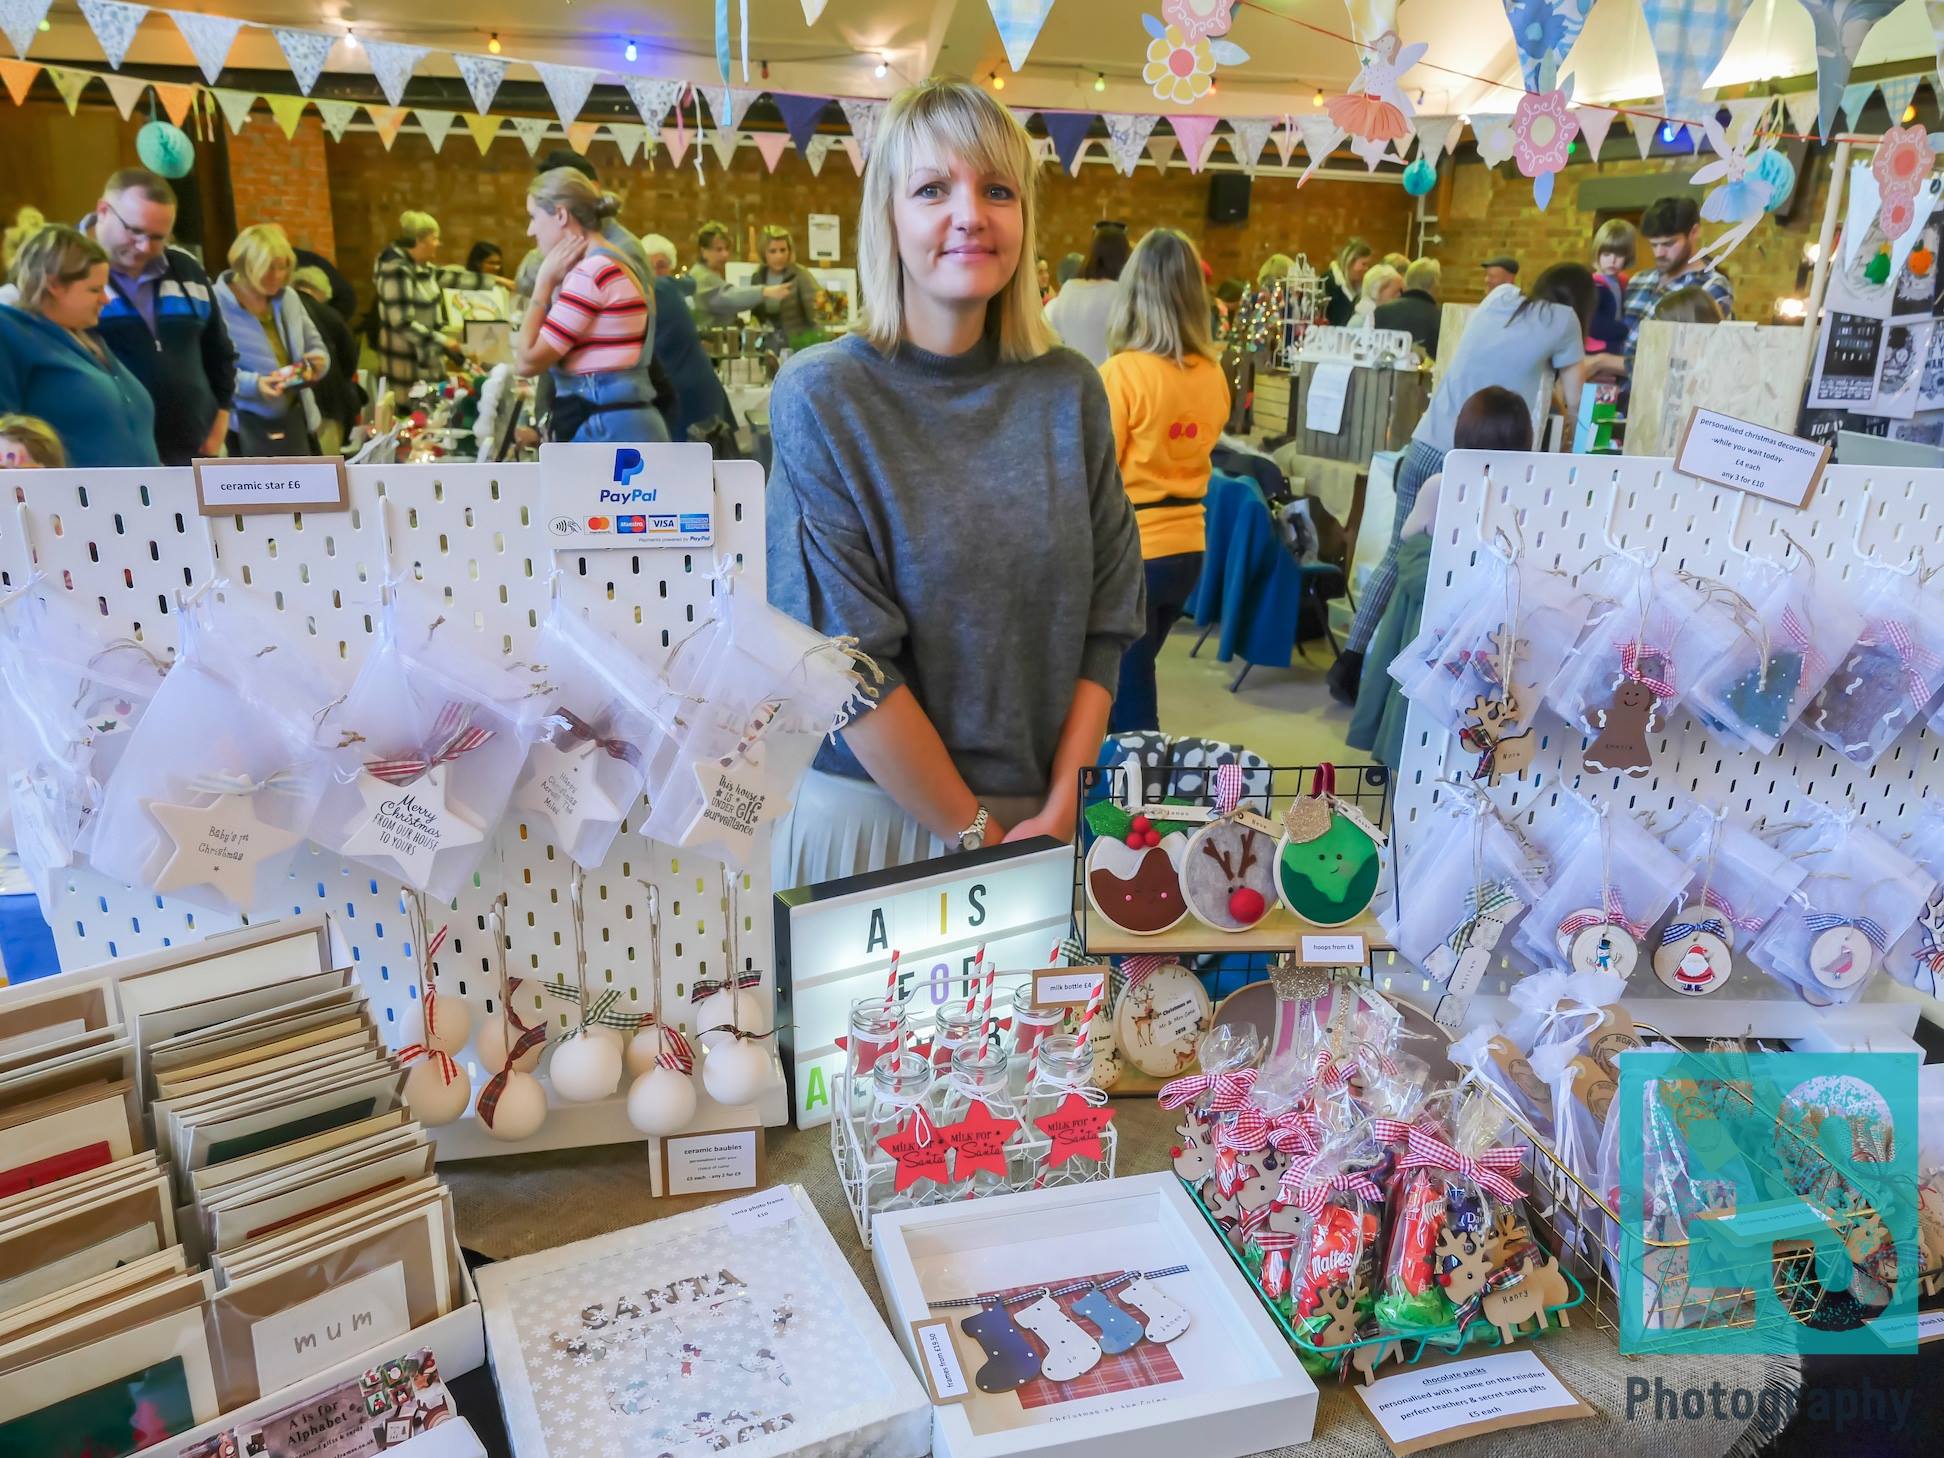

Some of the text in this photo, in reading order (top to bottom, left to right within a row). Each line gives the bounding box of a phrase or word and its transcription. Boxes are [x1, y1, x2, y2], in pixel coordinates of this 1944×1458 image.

[1700, 418, 1744, 434] personalised
[1744, 432, 1776, 446] christmas
[1778, 441, 1816, 457] decorations
[1733, 444, 1746, 452] you
[1748, 446, 1762, 456] wait
[1736, 459, 1760, 472] £4 each
[220, 480, 300, 490] ceramic star £6
[1722, 470, 1735, 480] any
[1740, 476, 1750, 484] for
[1752, 480, 1764, 488] £10
[600, 489, 657, 504] PayPal
[654, 520, 674, 528] VISA
[719, 774, 758, 802] This house
[724, 792, 734, 802] IS
[397, 794, 437, 824] Merry
[712, 796, 762, 824] UNDER elf
[380, 801, 440, 838] Christmas
[704, 808, 754, 836] surveillance
[208, 826, 249, 846] Baby's 1st
[372, 813, 440, 852] FROM OUR HOUSE
[198, 842, 244, 861] Christmas
[380, 831, 416, 856] TO YOURS
[866, 884, 987, 954] A IS
[1058, 1128, 1098, 1144] Santa
[684, 1144, 742, 1155] ceramic baubles
[902, 1150, 946, 1168] Santa
[961, 1142, 1002, 1158] Santa
[732, 1208, 748, 1216] santa
[748, 1204, 766, 1212] photo
[1312, 1250, 1354, 1280] Maltes
[581, 1268, 748, 1330] SANTA
[1502, 1290, 1528, 1304] Henry
[294, 1312, 372, 1354] mum
[929, 1333, 941, 1352] £19.50
[937, 1352, 946, 1367] from
[1422, 1366, 1487, 1386] chocolate packs
[1378, 1392, 1432, 1412] personalised
[1433, 1388, 1452, 1398] with
[1454, 1386, 1460, 1394] a
[1460, 1382, 1484, 1391] name
[1497, 1375, 1511, 1384] the
[1512, 1371, 1546, 1382] reindeer
[1400, 1406, 1431, 1421] perfect
[1432, 1398, 1469, 1412] teachers
[1478, 1392, 1504, 1402] secret
[1504, 1386, 1528, 1396] santa
[1528, 1384, 1546, 1394] gifts
[1469, 1406, 1502, 1418] £5 each
[290, 1402, 338, 1430] A is for
[288, 1412, 347, 1447] Alphabet
